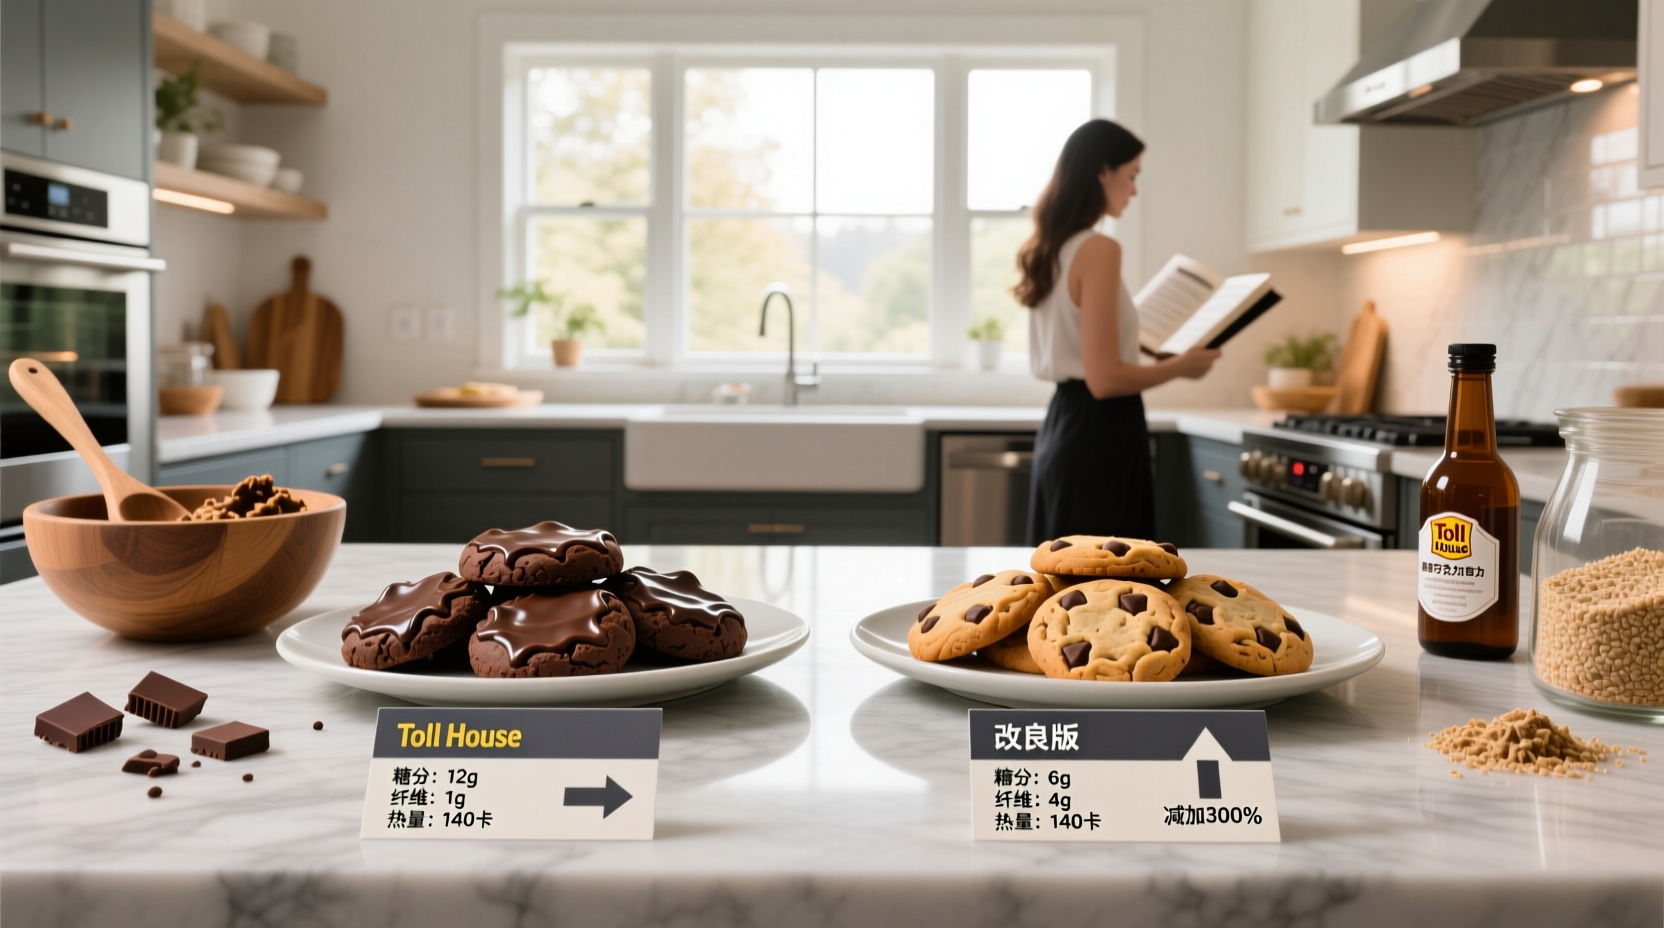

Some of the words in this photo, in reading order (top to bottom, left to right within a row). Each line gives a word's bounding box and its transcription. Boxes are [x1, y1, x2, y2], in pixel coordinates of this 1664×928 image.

[1434, 523, 1465, 542] Toll
[397, 722, 441, 748] Toll
[445, 722, 522, 748] House
[994, 722, 1080, 751] 改良版
[1163, 804, 1263, 826] 减加300%
